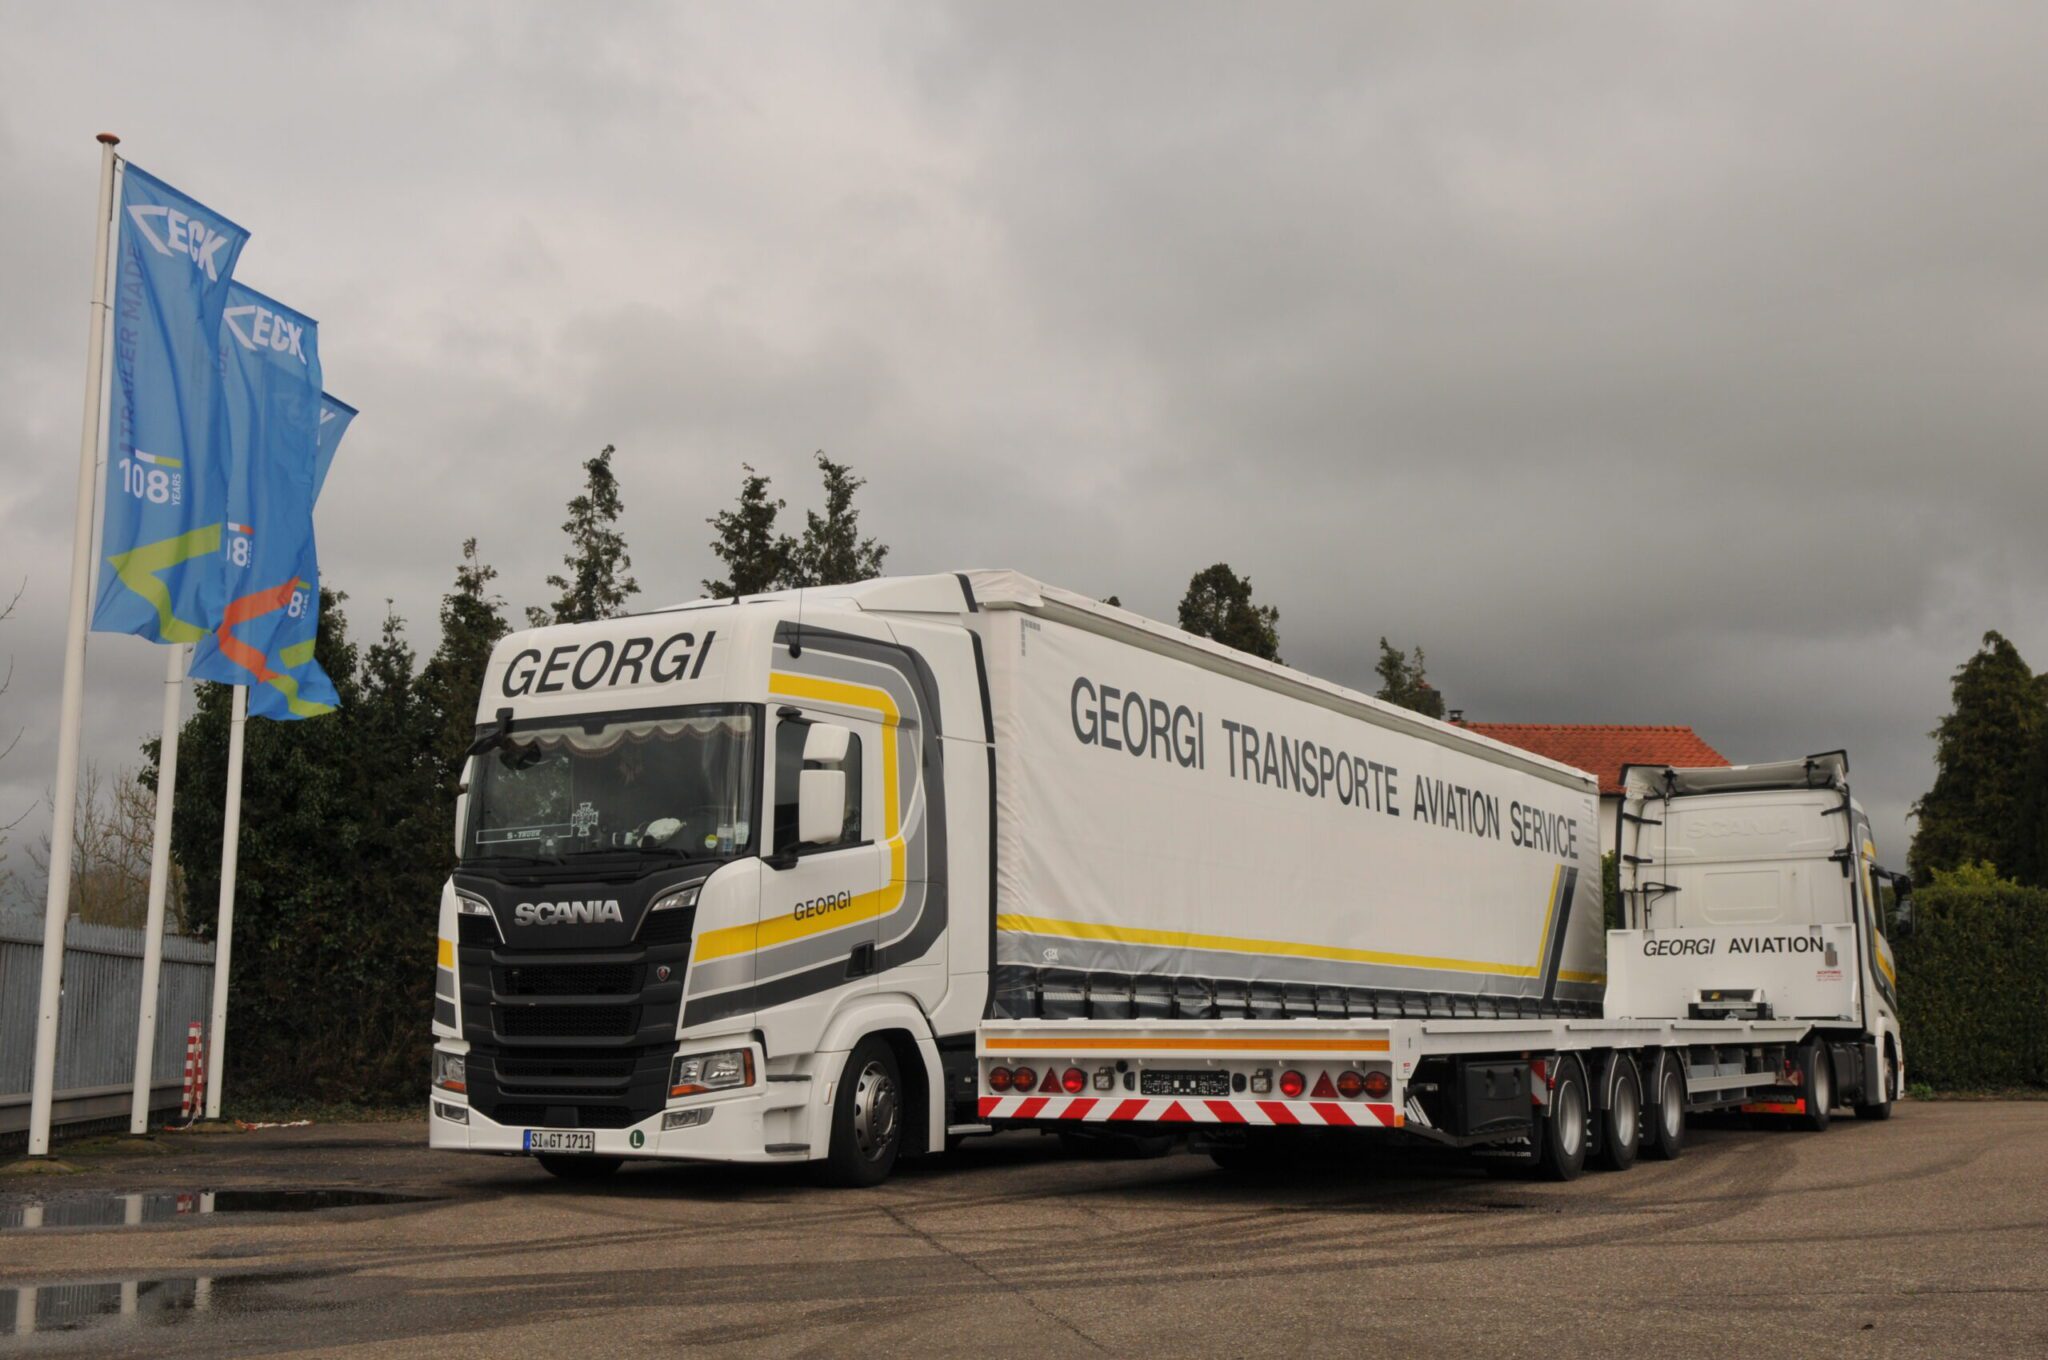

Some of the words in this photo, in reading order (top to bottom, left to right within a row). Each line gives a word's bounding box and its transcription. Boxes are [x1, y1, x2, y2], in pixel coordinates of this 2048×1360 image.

[170, 472, 182, 506] YEARS
[502, 630, 717, 698] GEORGI
[1070, 676, 1205, 770] GEORGI
[1221, 719, 1400, 817] TRANSPORTE
[1413, 774, 1500, 840] AVIATION
[1510, 800, 1579, 860] SERVICE
[513, 900, 624, 927] SCANIA
[793, 889, 852, 921] GEORGI
[1643, 939, 1716, 957] GEORGI
[1728, 936, 1824, 954] AVIATION
[531, 1133, 543, 1148] SI
[549, 1133, 565, 1149] GT
[565, 1133, 591, 1150] 1711
